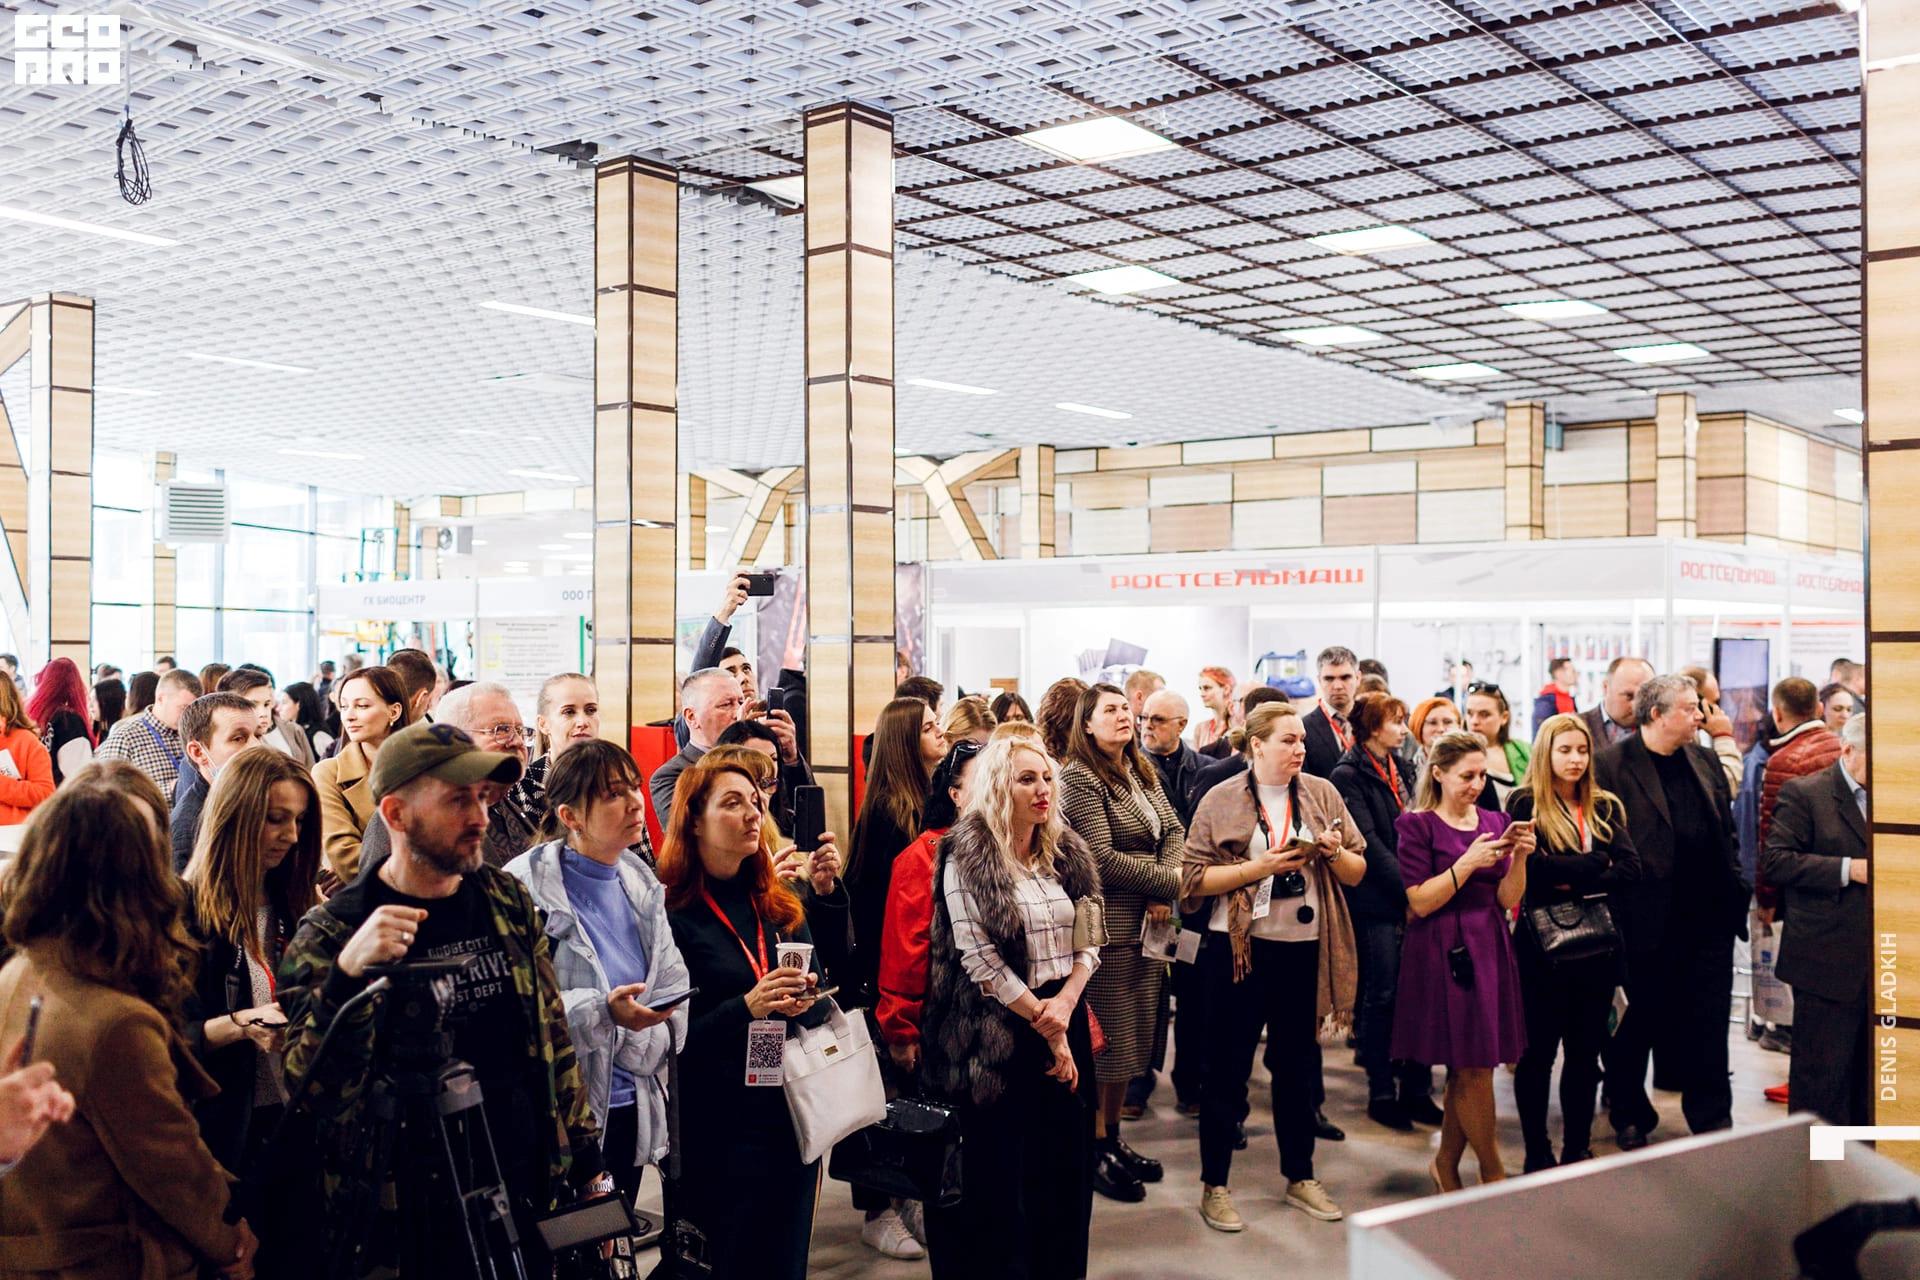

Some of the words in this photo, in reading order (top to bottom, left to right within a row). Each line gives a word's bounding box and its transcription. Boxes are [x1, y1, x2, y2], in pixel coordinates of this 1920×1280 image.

[1111, 568, 1363, 590] РОСТСЕЛЬМАШ
[1680, 560, 1776, 585] РОСТСЕЛЬМАШ
[377, 595, 426, 606] БИОЦЕНТР
[465, 935, 489, 952] CITY
[474, 981, 504, 999] DEPT
